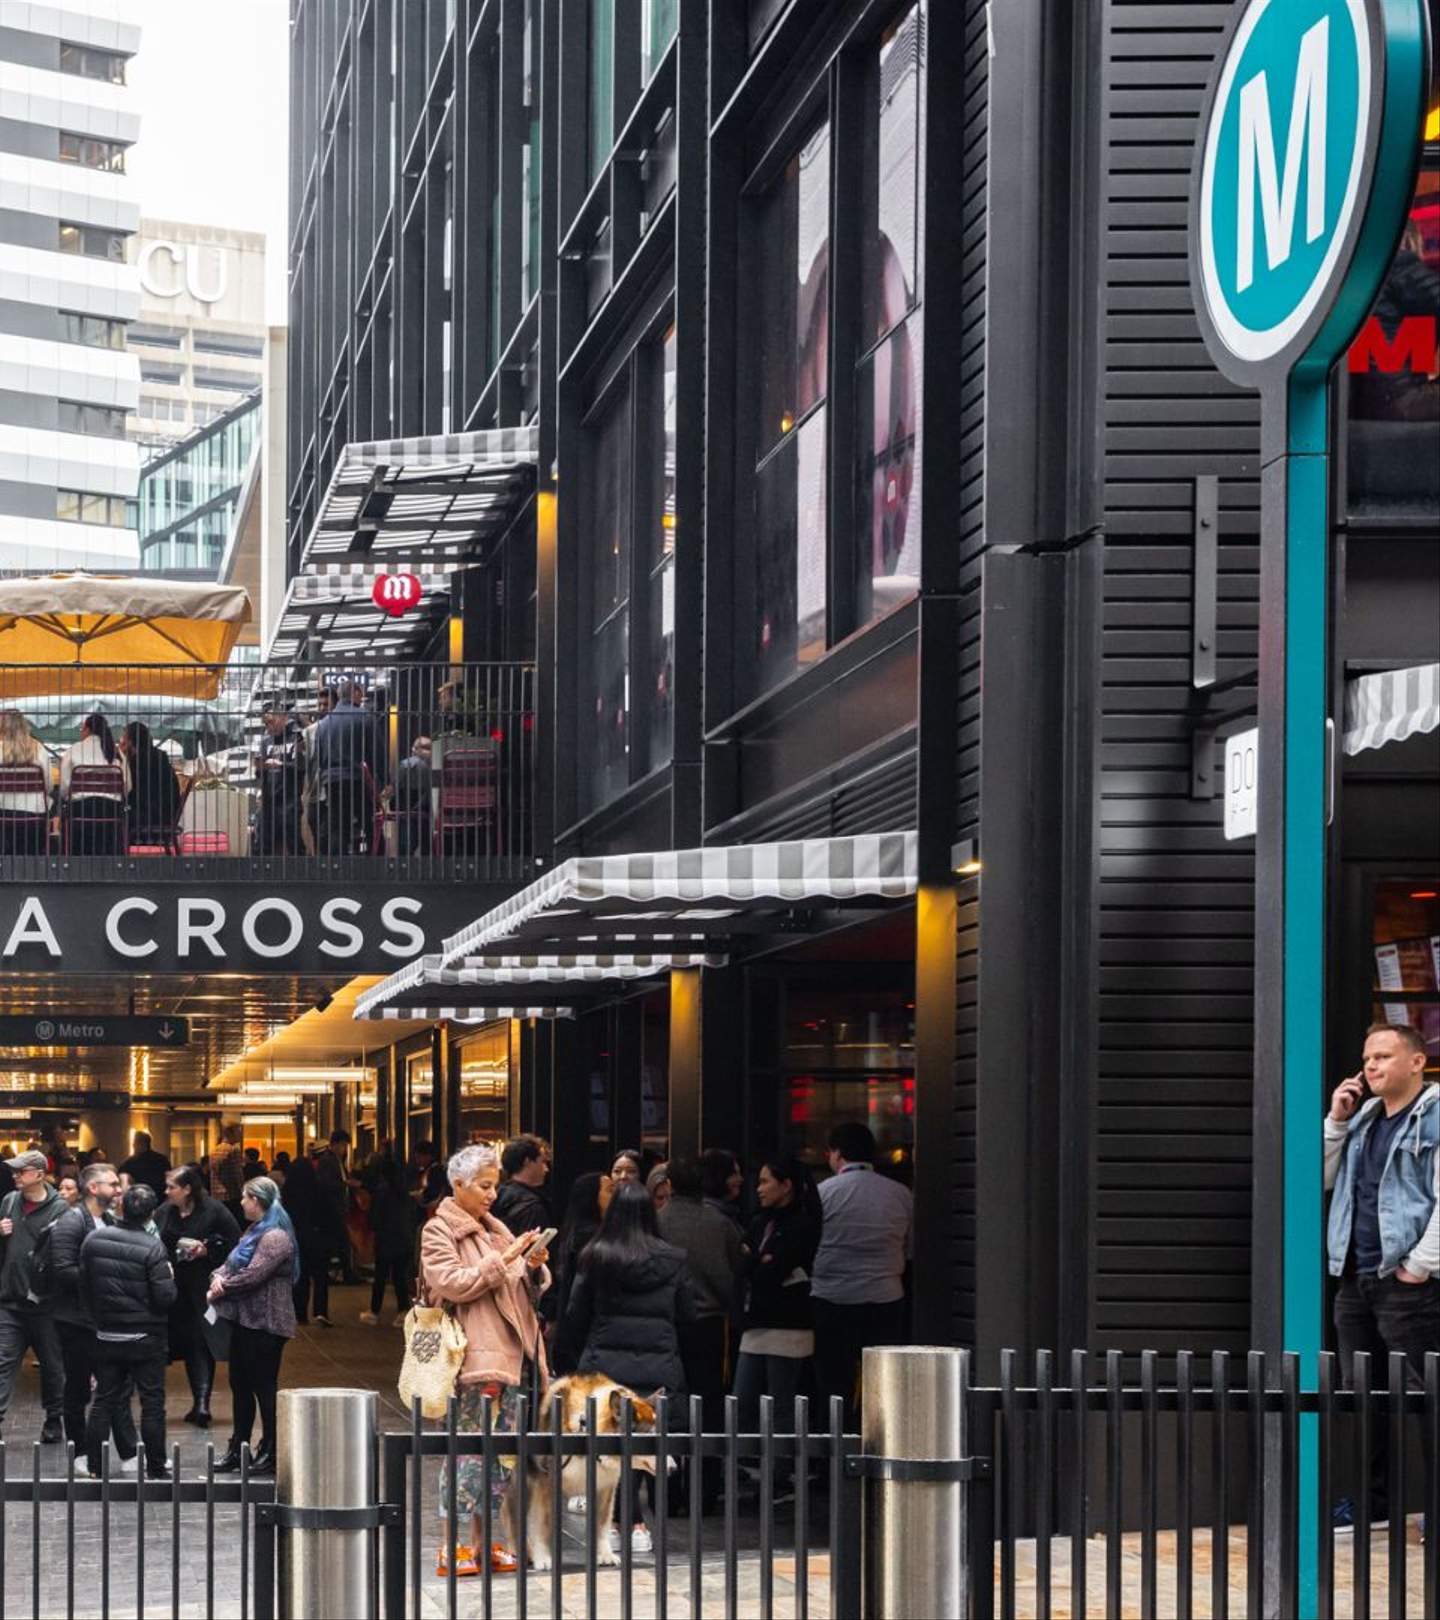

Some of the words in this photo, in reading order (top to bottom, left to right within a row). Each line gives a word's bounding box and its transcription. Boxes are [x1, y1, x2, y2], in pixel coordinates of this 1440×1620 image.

[1236, 14, 1329, 295] M
[104, 896, 426, 958] CROSS
[59, 1022, 105, 1037] Metro
